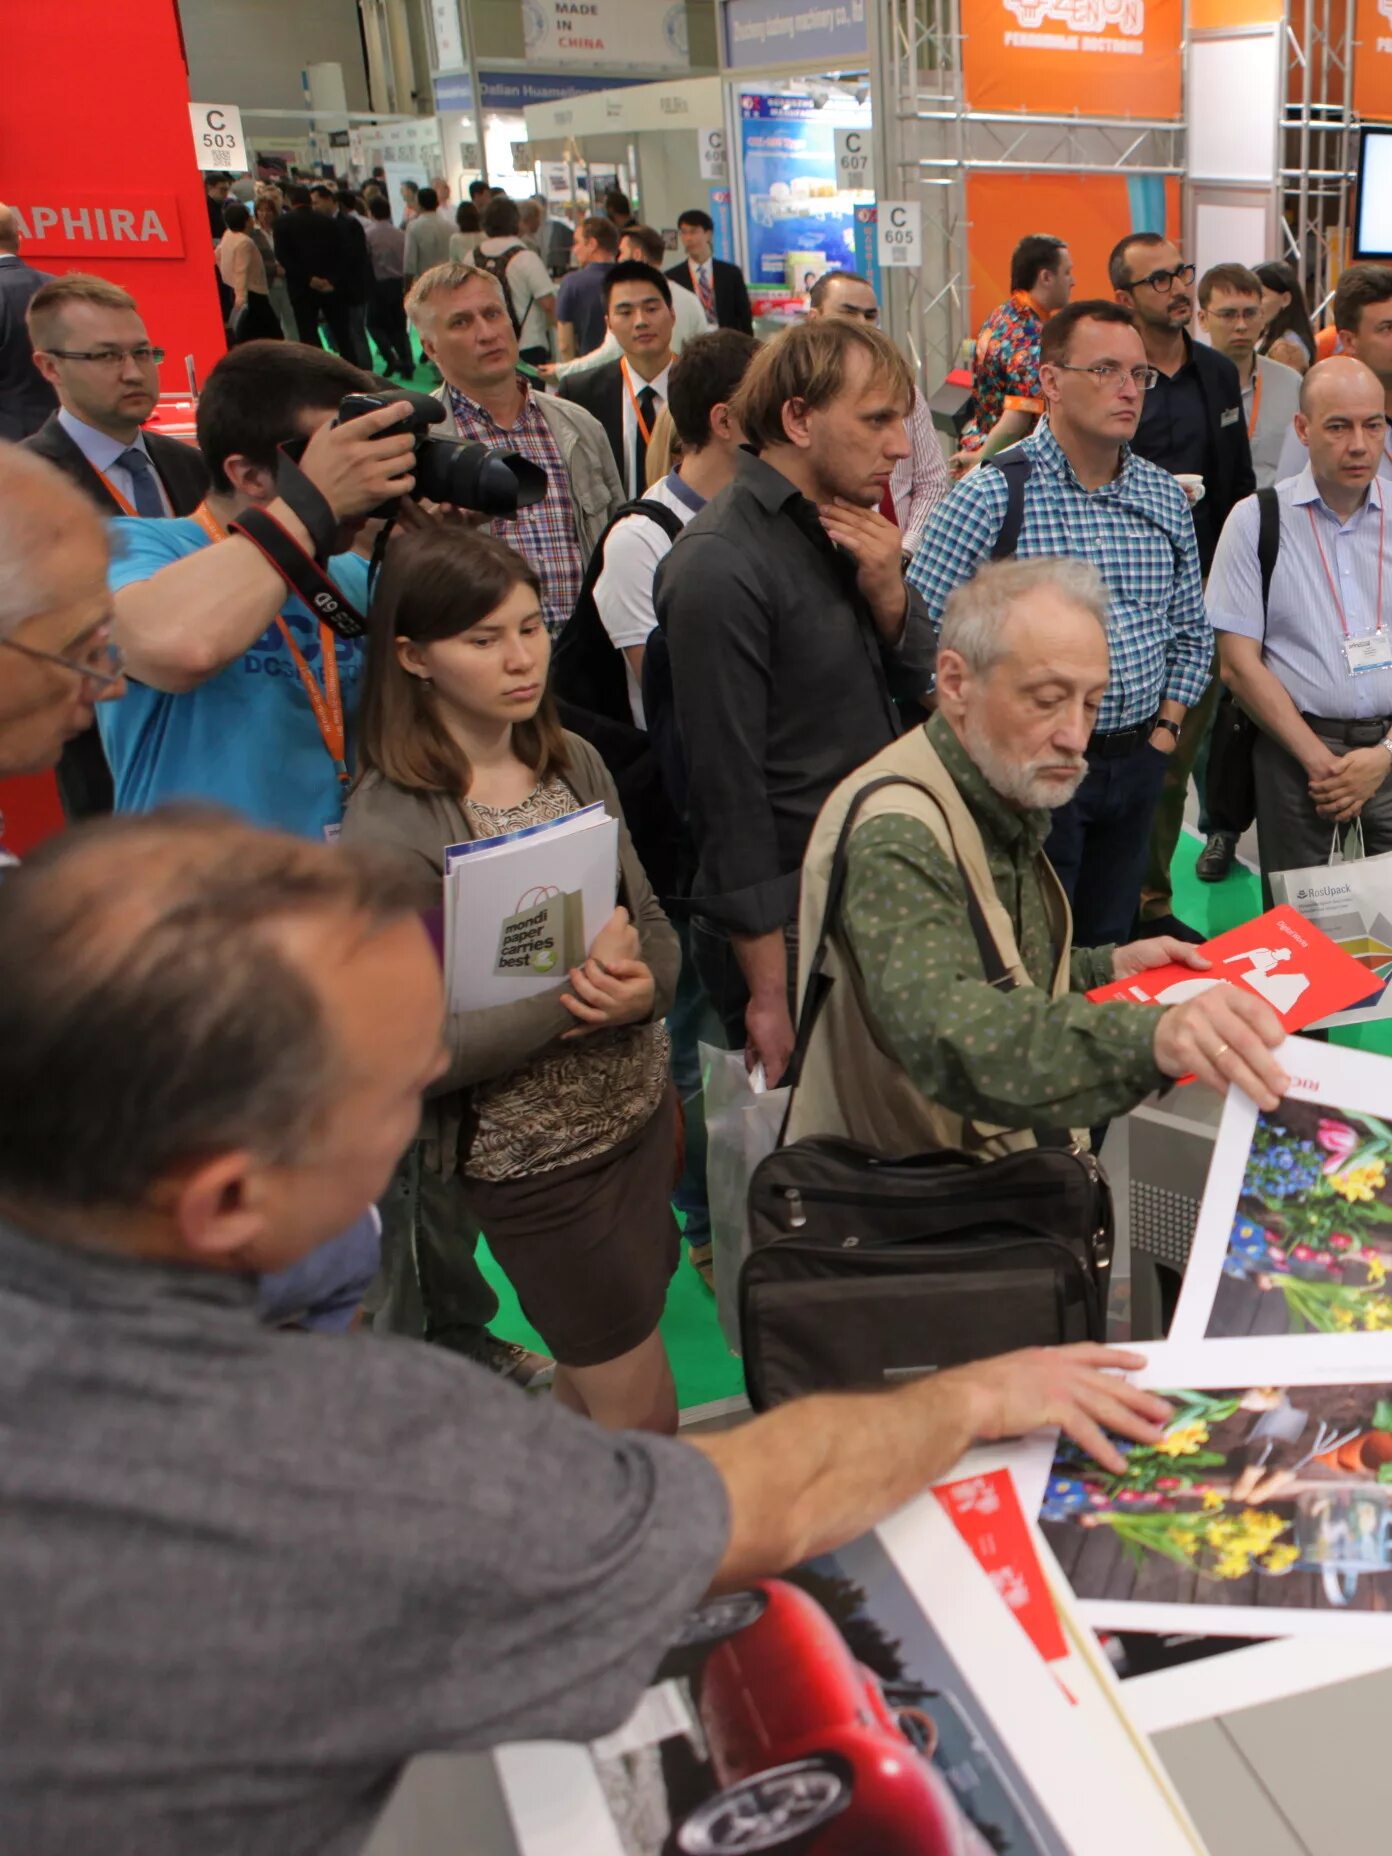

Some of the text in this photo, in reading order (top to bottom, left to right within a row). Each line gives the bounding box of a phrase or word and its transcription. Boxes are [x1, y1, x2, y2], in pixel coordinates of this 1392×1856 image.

[555, 2, 599, 16] MADE
[556, 19, 572, 31] IN
[558, 37, 605, 50] CHINA
[206, 110, 227, 131] C
[203, 134, 236, 149] 503
[708, 132, 722, 148] C
[846, 133, 862, 154] C
[704, 150, 726, 162] 60
[841, 156, 868, 170] 607
[8, 205, 169, 242] APHIRA
[890, 207, 907, 228] C
[885, 230, 914, 245] 605
[314, 592, 339, 613] 6D
[1308, 884, 1352, 898] RosUpack
[505, 909, 549, 934] mondi
[503, 925, 545, 947] paper
[500, 937, 555, 956] carries
[498, 954, 531, 968] best
